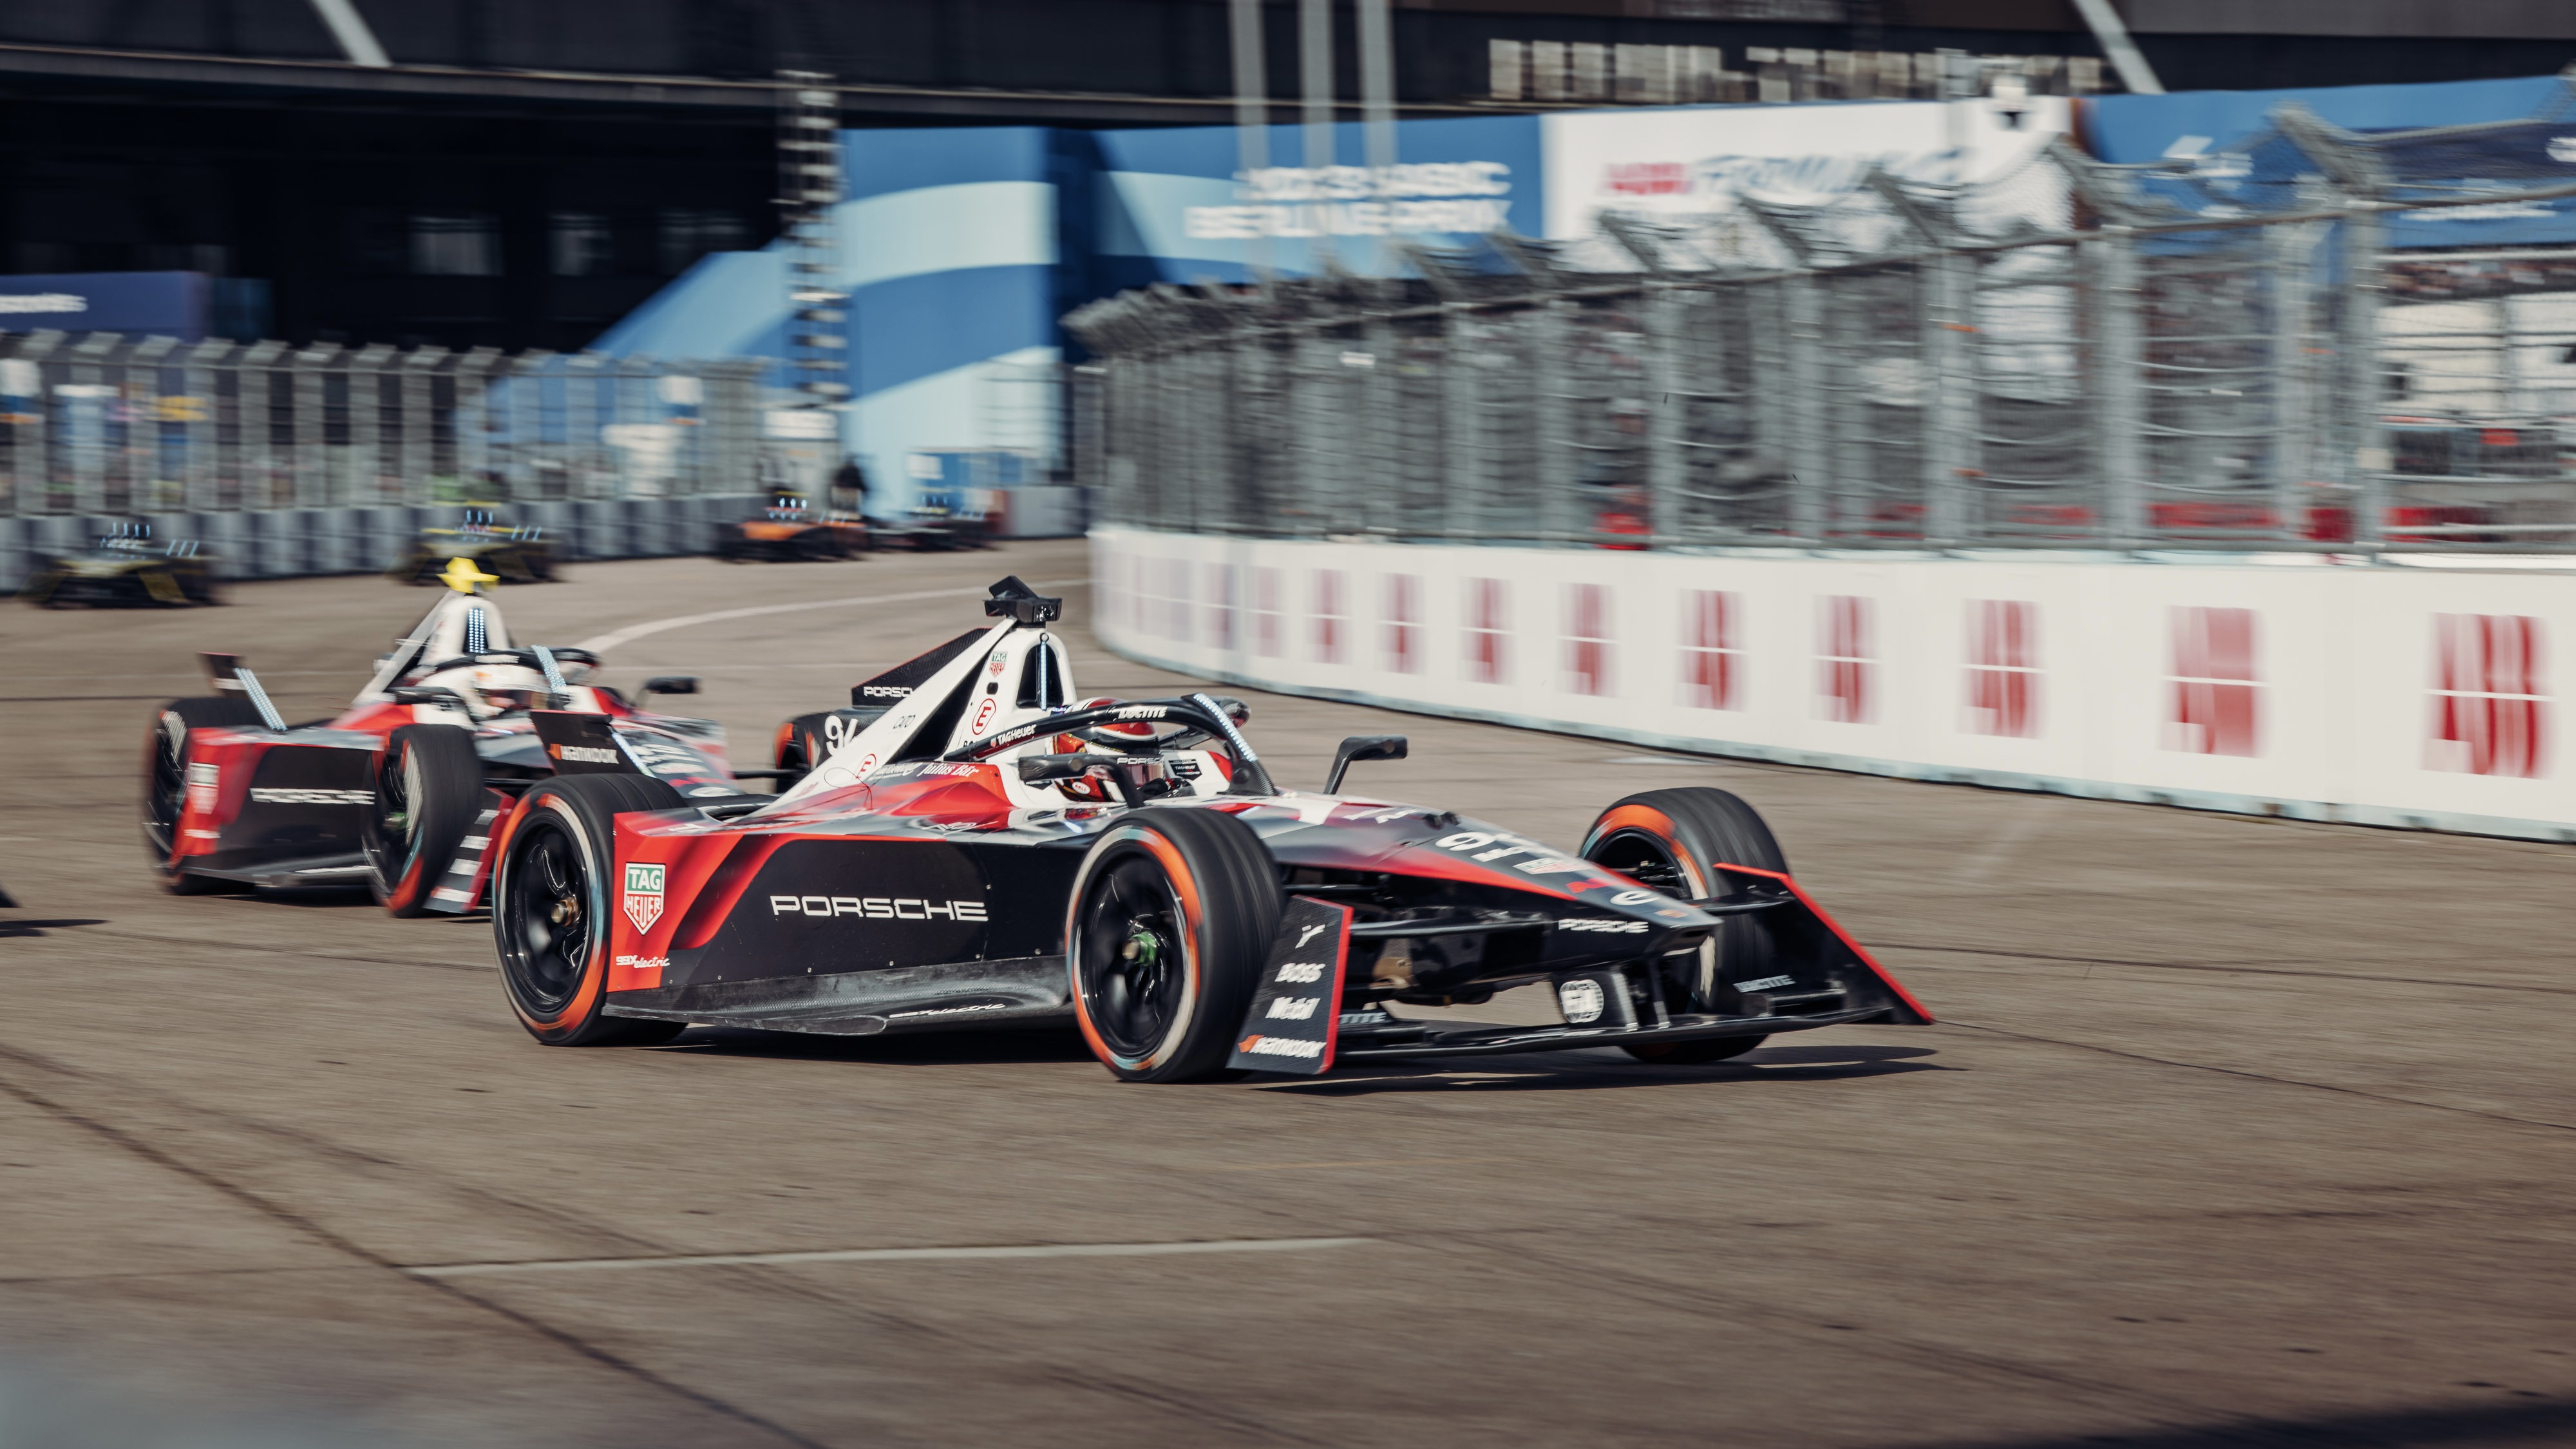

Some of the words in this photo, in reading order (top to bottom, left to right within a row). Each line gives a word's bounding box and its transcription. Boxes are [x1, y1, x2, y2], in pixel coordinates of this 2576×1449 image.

[990, 663, 1005, 676] HEUER
[864, 687, 912, 697] PORSC
[1119, 706, 1168, 719] LOCTITE
[1117, 757, 1164, 765] PORSC
[917, 763, 954, 777] Julius
[629, 869, 661, 891] TAG
[627, 895, 661, 928] HEUER
[770, 895, 988, 922] PORSCHE
[1339, 1012, 1387, 1024] TITE
